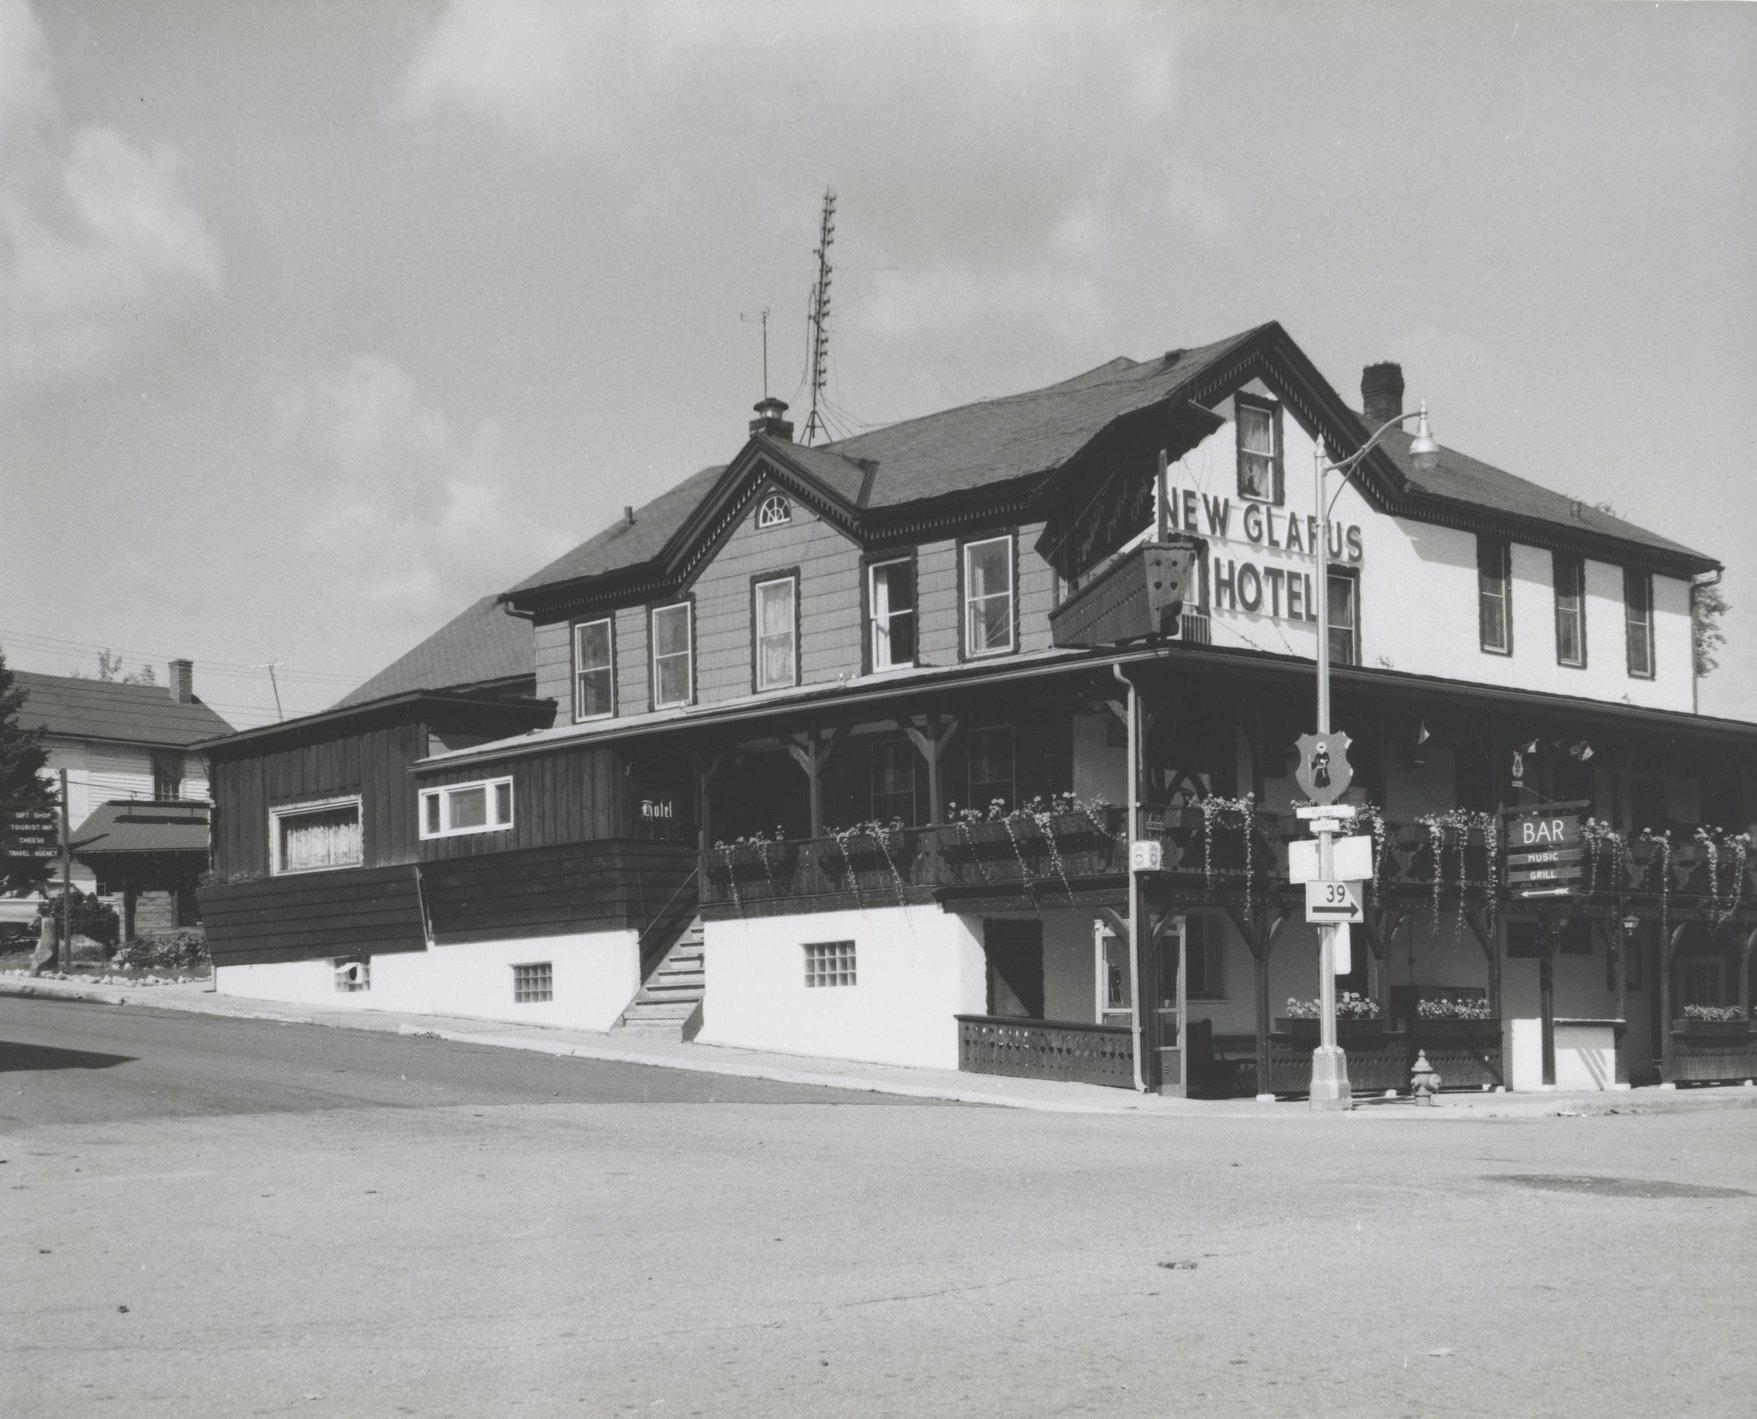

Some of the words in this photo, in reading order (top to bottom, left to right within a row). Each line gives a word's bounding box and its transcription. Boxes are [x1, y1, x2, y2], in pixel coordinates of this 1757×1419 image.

[1164, 487, 1229, 537] NEW
[1213, 557, 1318, 622] HOTEL
[641, 800, 672, 819] Hotel
[1523, 820, 1564, 844] BAR
[1527, 853, 1559, 863] MUSIC
[1530, 870, 1557, 880] GRILL
[1326, 885, 1345, 903] 39
